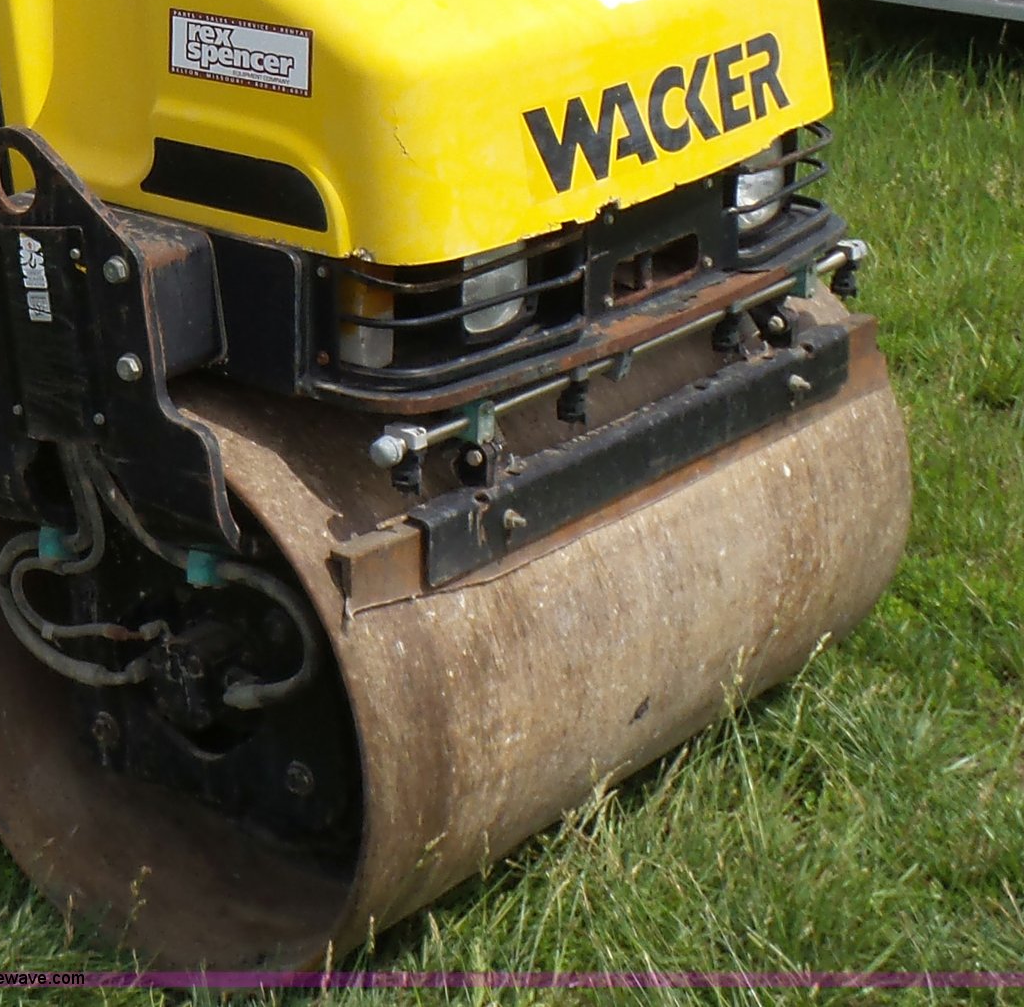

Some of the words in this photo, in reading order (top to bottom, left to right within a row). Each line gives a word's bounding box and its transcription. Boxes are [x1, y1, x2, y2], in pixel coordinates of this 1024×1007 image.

[186, 22, 234, 48] rex
[186, 41, 295, 78] spencer
[522, 32, 791, 194] WACKER
